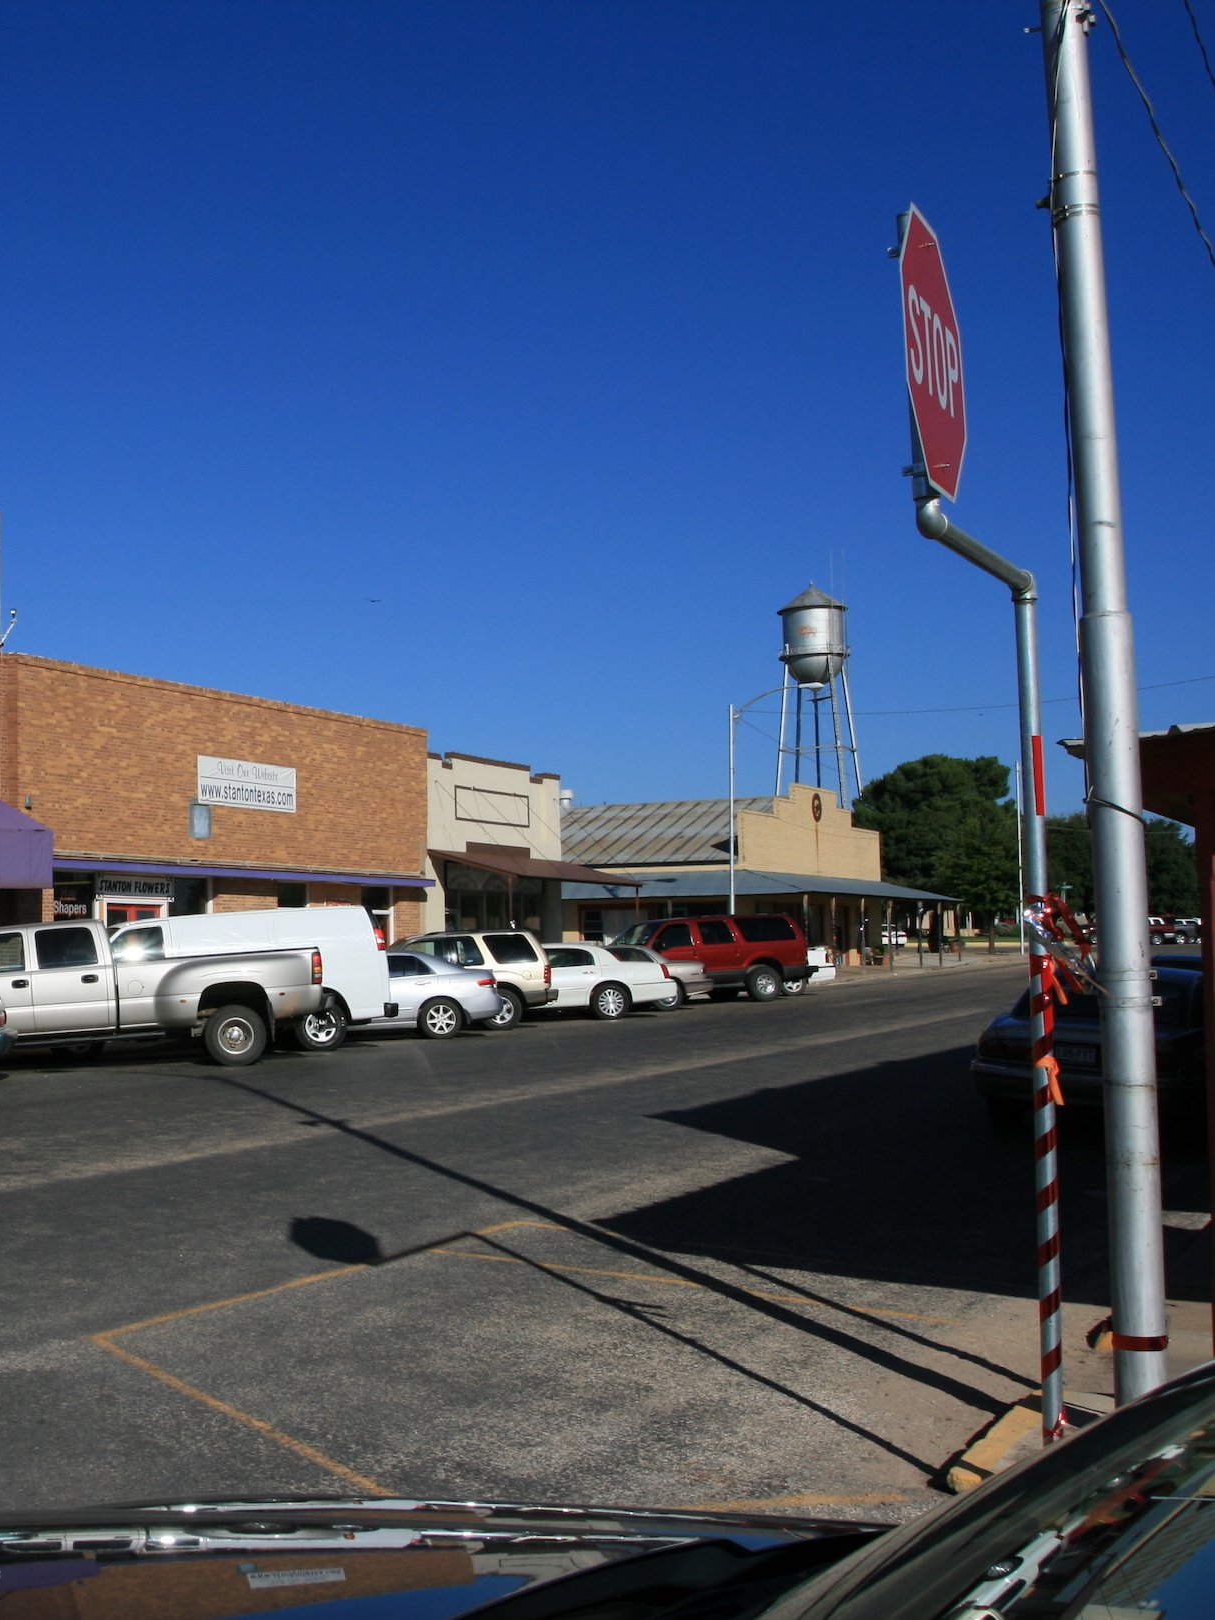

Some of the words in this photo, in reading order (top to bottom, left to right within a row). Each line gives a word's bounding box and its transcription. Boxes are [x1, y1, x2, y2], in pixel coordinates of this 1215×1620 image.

[907, 284, 959, 419] STOP
[217, 761, 234, 776] Visit
[237, 763, 249, 778] Our
[253, 766, 279, 781] Website
[200, 782, 294, 806] www.stantontexas.com
[100, 880, 132, 893] STANTON
[134, 880, 170, 894] FLOWERS
[54, 900, 87, 917] Shapers
